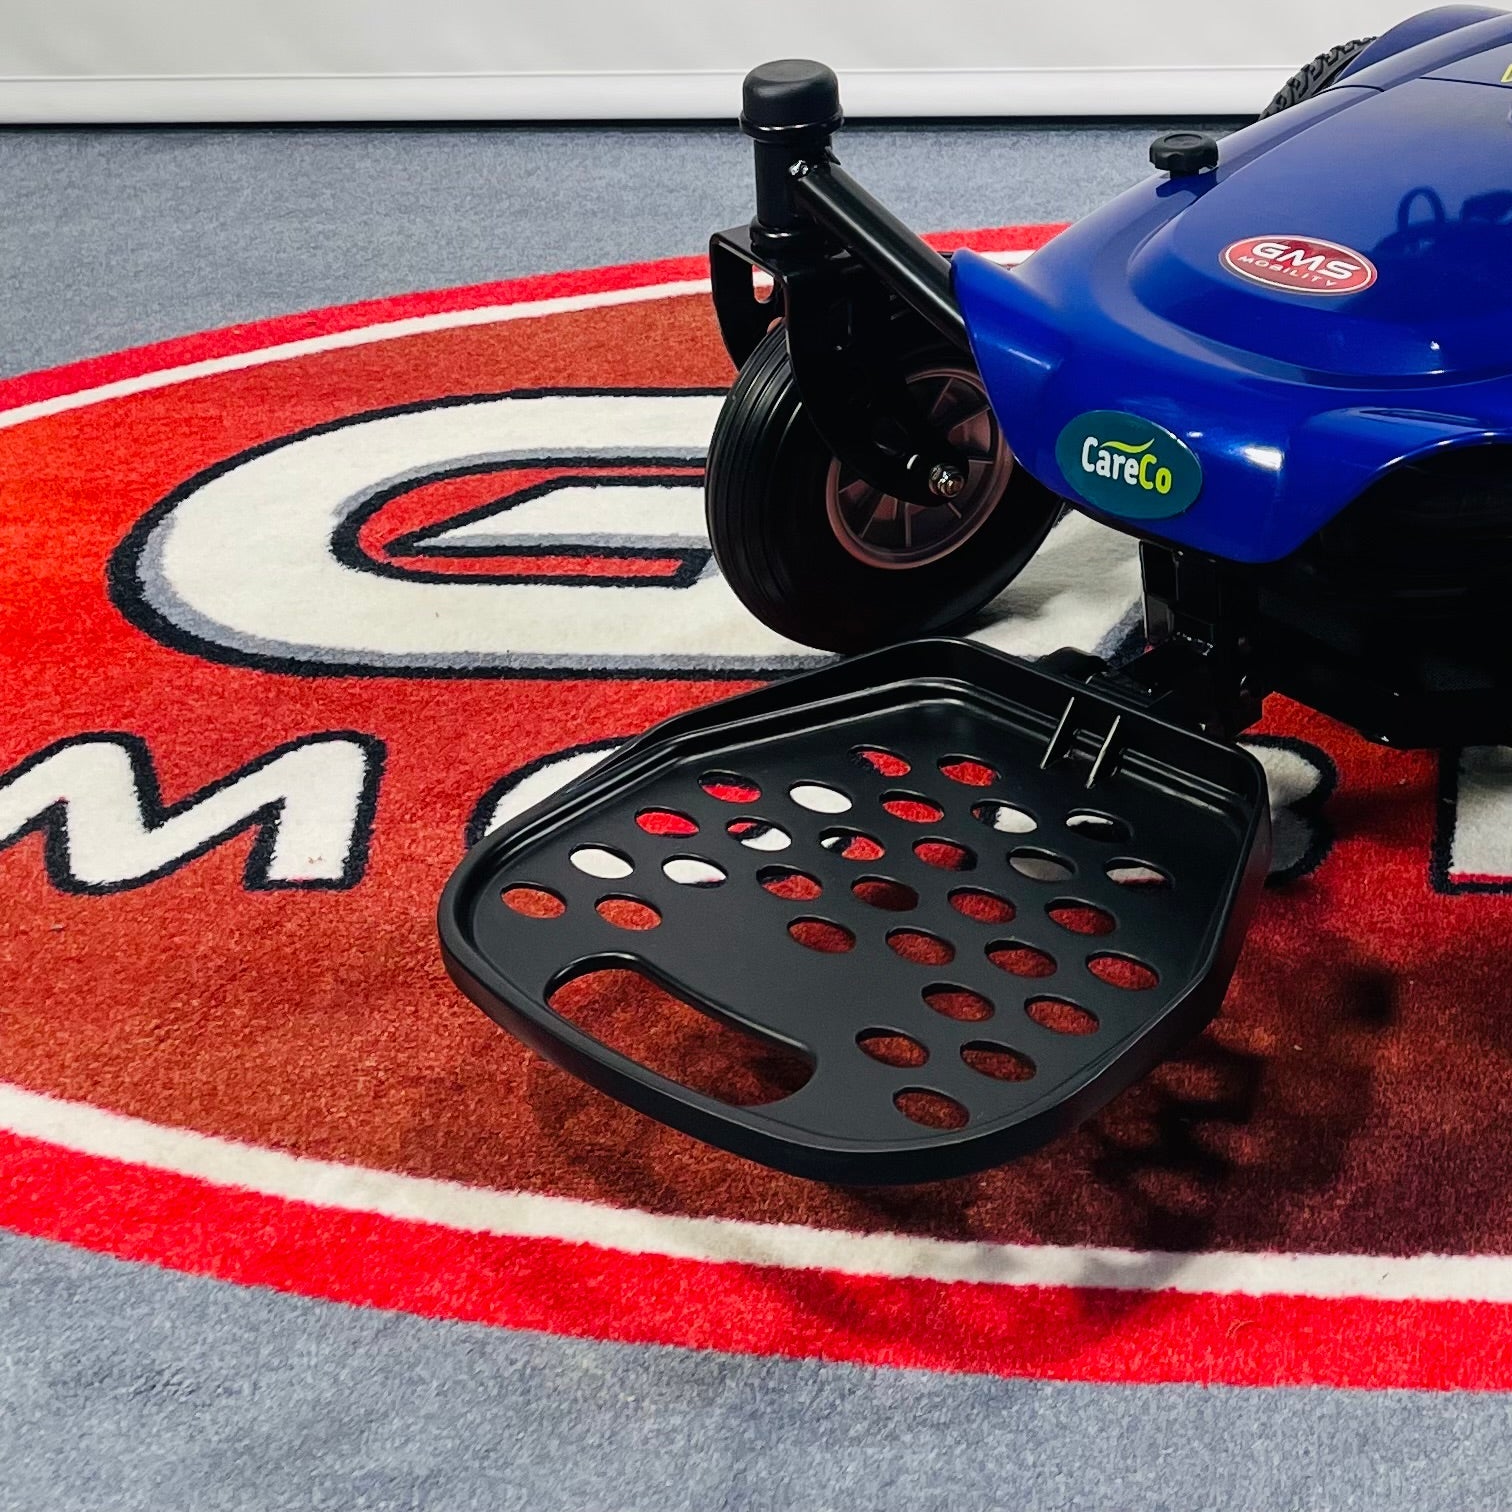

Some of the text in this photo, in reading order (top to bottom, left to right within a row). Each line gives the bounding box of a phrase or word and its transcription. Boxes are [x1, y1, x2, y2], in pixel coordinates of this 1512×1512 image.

[1236, 255, 1338, 287] MOBILITY
[1251, 241, 1362, 280] GMS
[1081, 436, 1172, 495] CareCo
